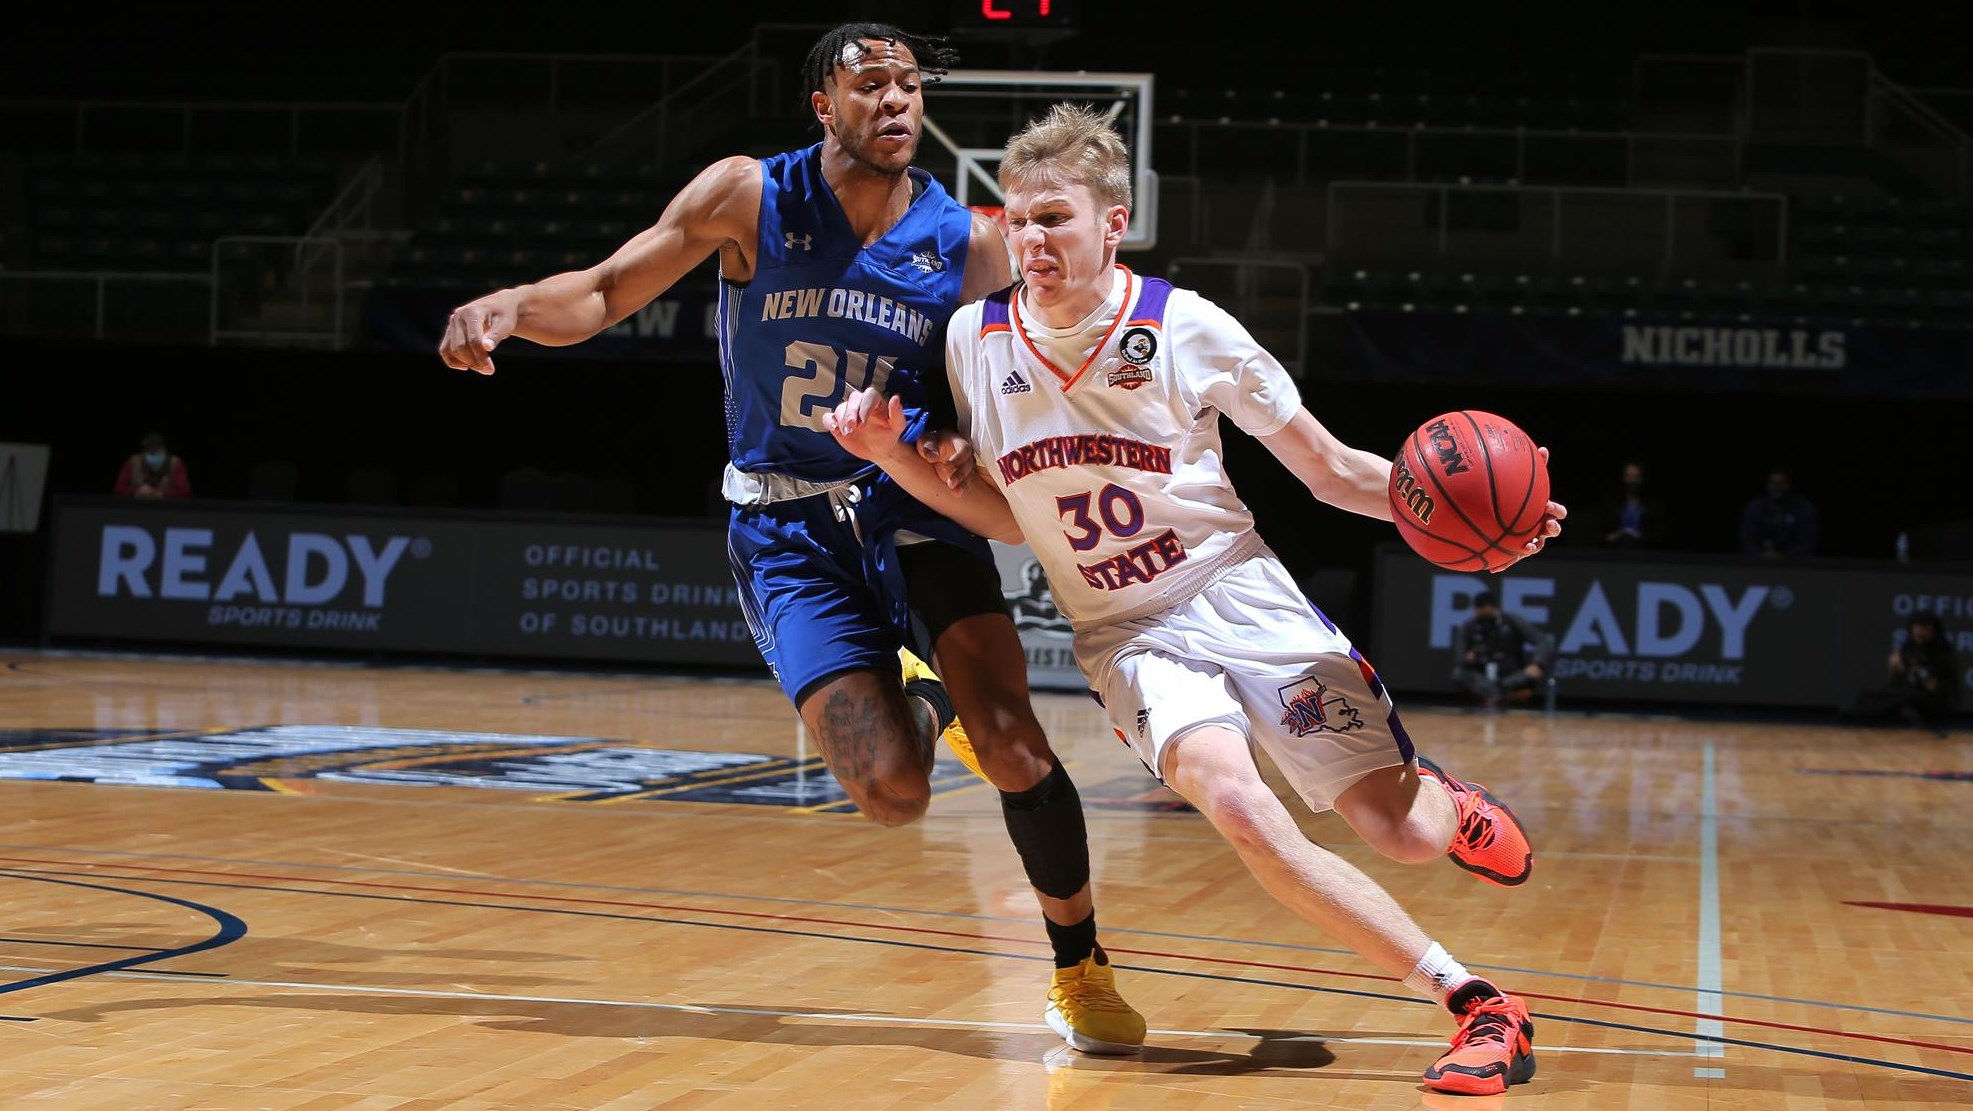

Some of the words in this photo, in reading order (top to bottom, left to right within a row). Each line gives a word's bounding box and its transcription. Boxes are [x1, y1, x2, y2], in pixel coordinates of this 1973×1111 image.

[761, 288, 826, 322] NEW
[827, 288, 934, 348] ORLEANS
[1620, 324, 1847, 371] NICHOLLS
[1001, 384, 1031, 395] adidas
[1108, 369, 1152, 386] SOUTHLAND
[997, 433, 1173, 487] NORTHWESTERN
[1425, 418, 1470, 477] NCAA
[1393, 446, 1435, 526] Wils
[1055, 482, 1145, 553] 30
[98, 525, 411, 609] READY
[524, 544, 660, 571] OFFICIAL
[1077, 528, 1188, 591] STATE
[522, 577, 639, 605] SPORTS
[207, 604, 301, 629] SPORTS
[307, 609, 382, 632] DRINK
[519, 611, 557, 635] OF
[570, 613, 751, 643] SOUTHLAND
[1428, 574, 1770, 660] READY
[1552, 657, 1656, 682] SPORTS
[1661, 660, 1743, 684] DRINK
